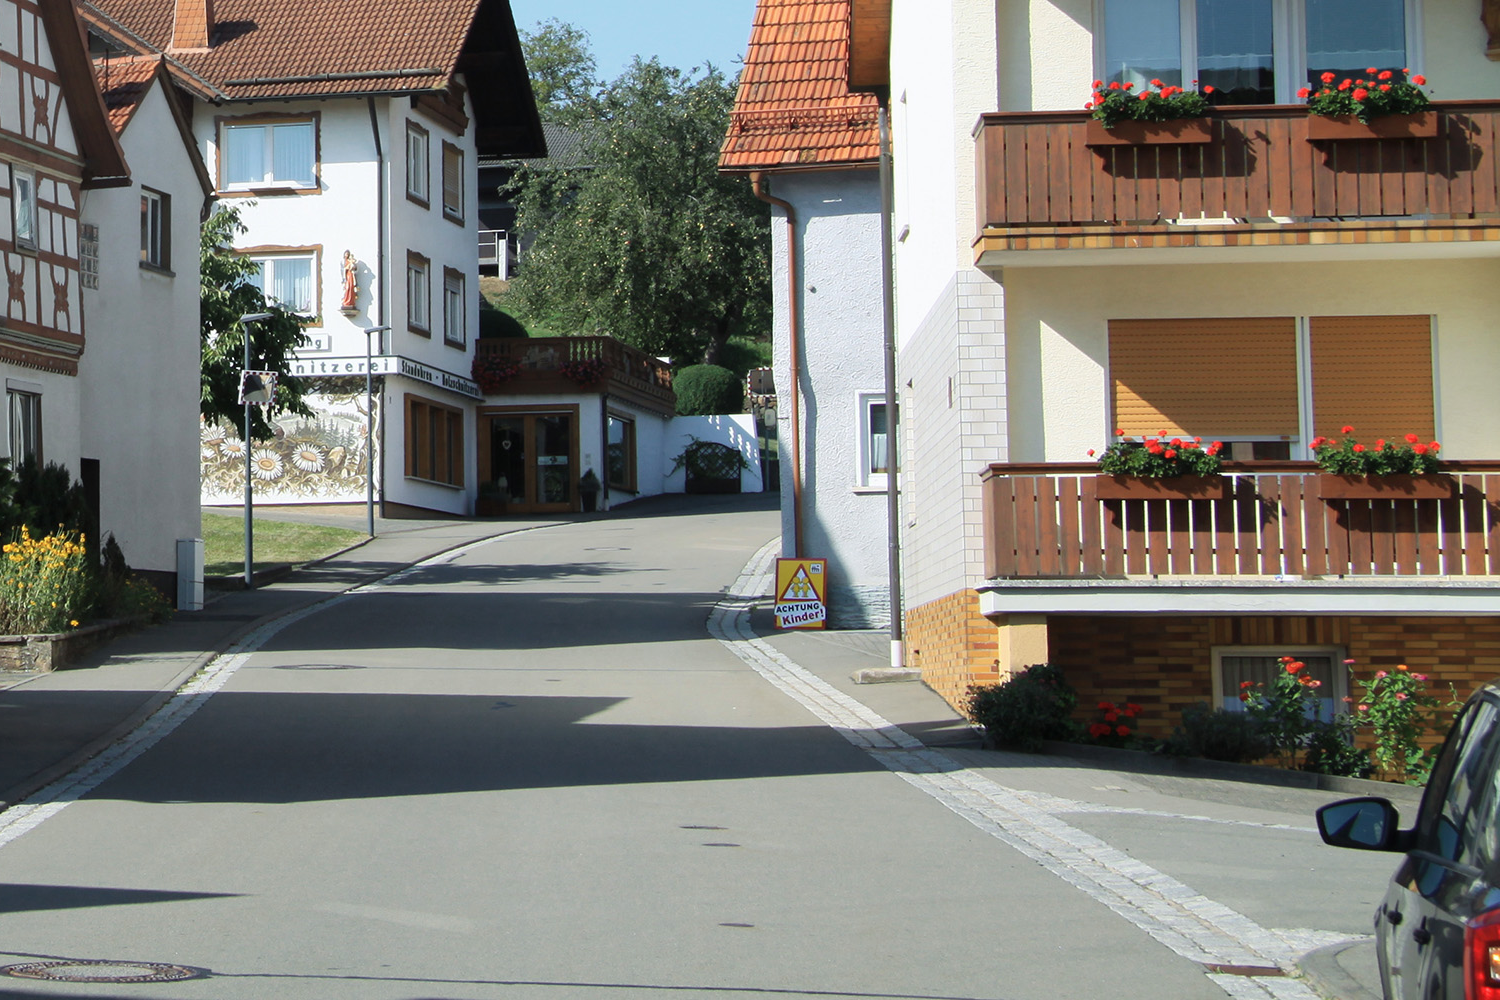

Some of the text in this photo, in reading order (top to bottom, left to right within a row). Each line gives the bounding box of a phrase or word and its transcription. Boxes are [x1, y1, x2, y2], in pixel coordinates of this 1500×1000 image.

[296, 358, 388, 374] nitzerei
[776, 602, 820, 613] ACHTUNG
[782, 608, 824, 626] Kinder!
